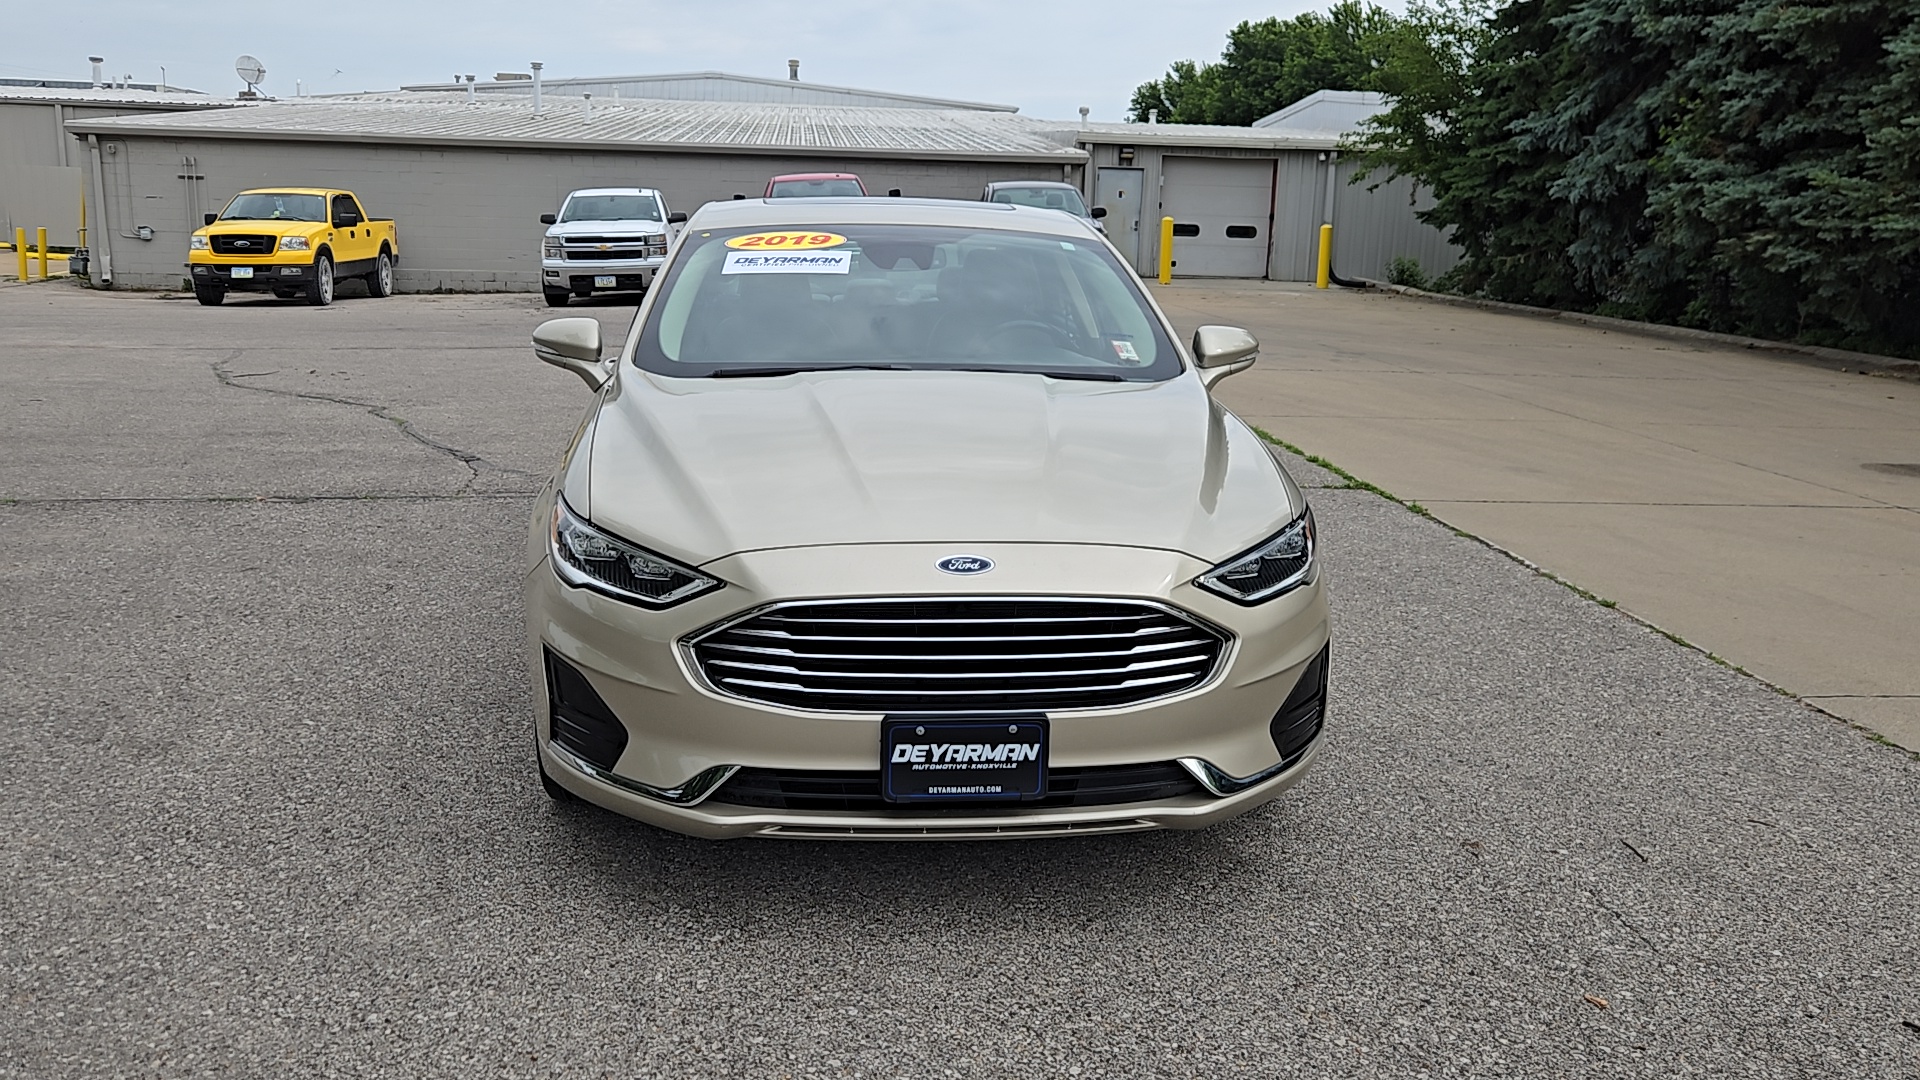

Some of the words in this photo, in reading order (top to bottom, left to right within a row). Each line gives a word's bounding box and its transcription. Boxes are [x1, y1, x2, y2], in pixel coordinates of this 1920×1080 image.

[738, 234, 833, 247] 2019
[733, 256, 844, 264] DEYARMAN
[948, 558, 981, 570] Ford
[890, 743, 1041, 763] DEYARMAN
[928, 785, 1002, 794] DEYARMANAUTO.COM
